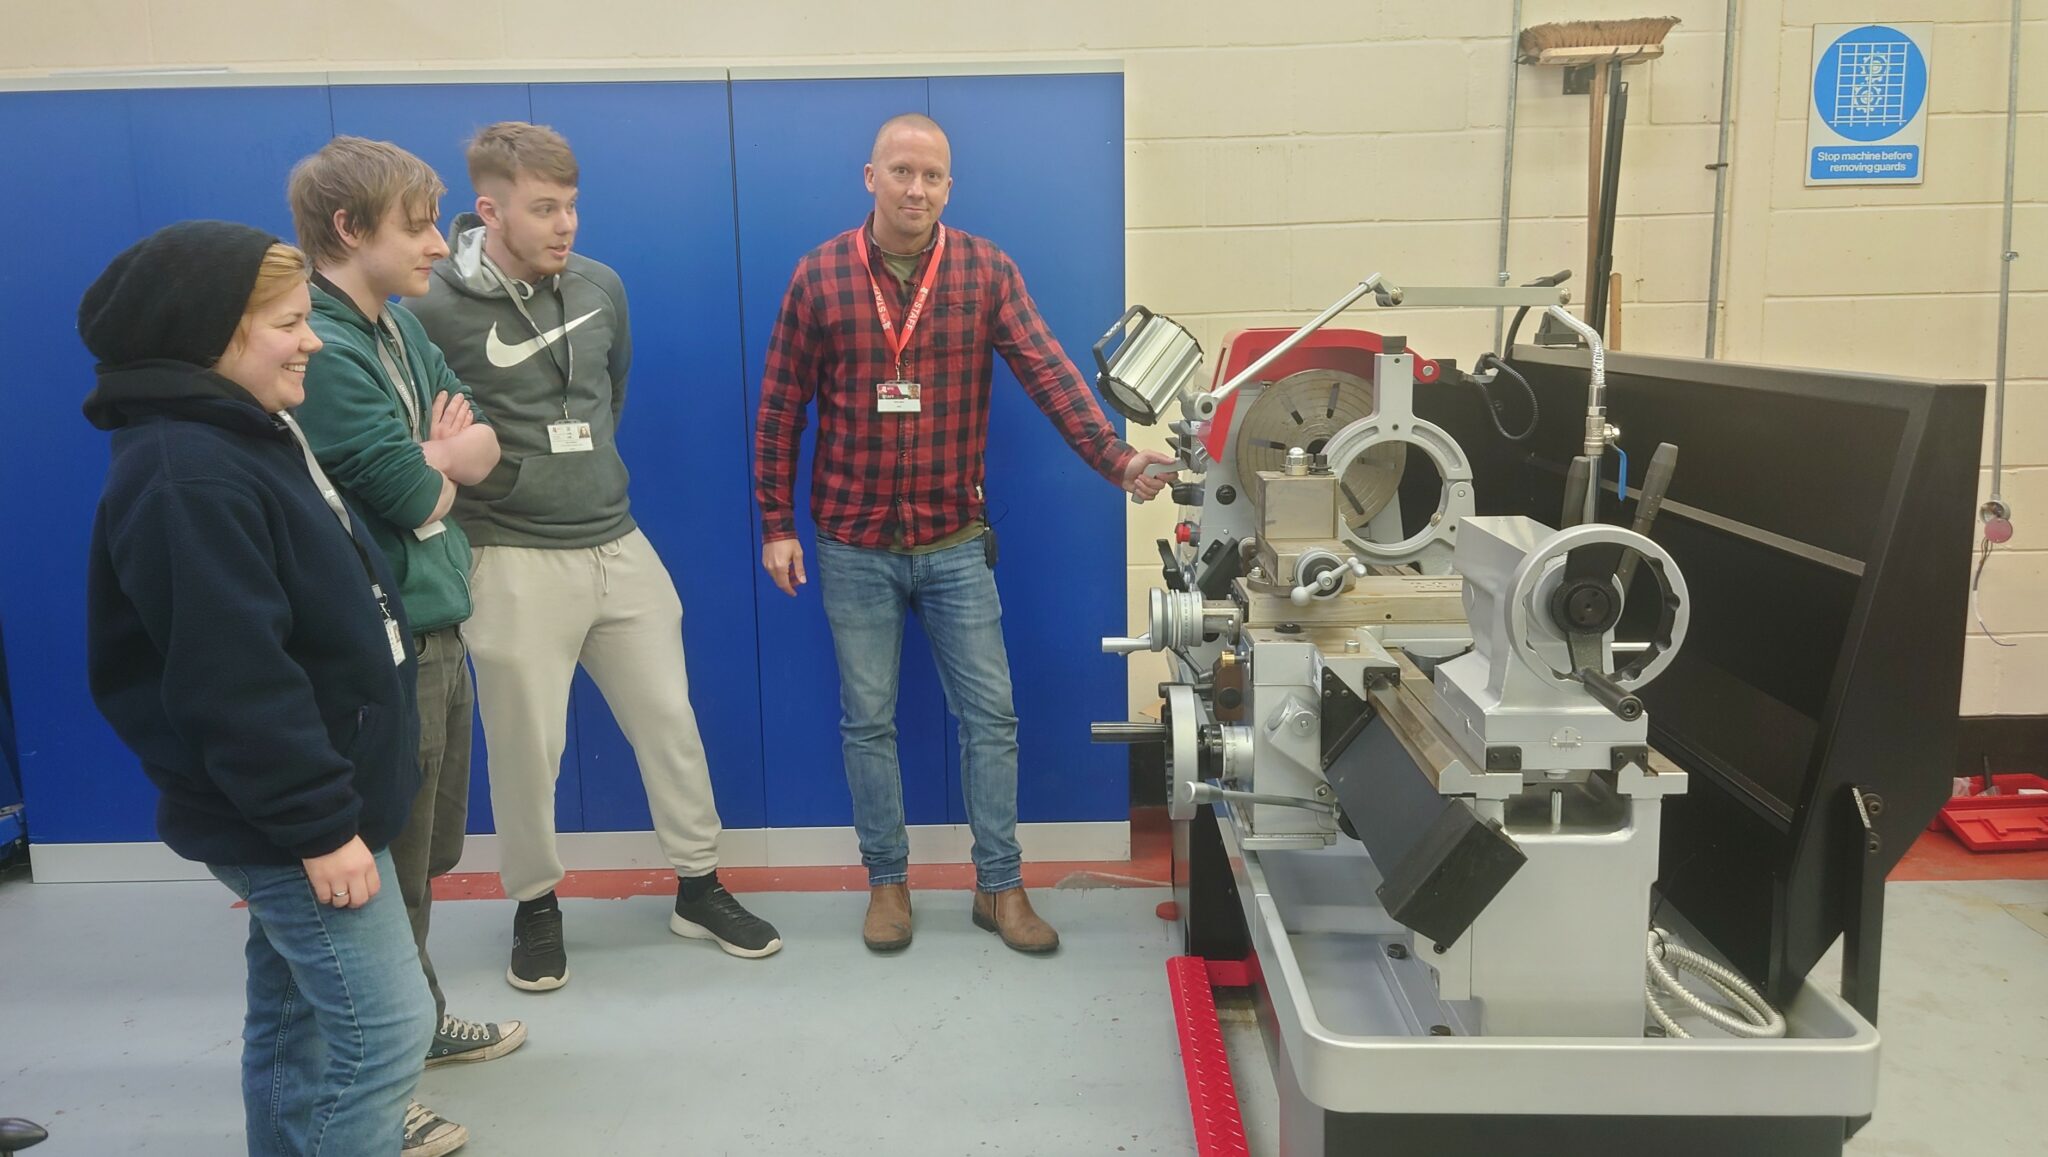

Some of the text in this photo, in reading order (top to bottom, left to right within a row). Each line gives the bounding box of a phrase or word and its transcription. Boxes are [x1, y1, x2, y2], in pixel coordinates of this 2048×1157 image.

[1817, 151, 1913, 162] Stop machine before
[1829, 162, 1906, 173] removing guards
[904, 301, 923, 331] STAFF
